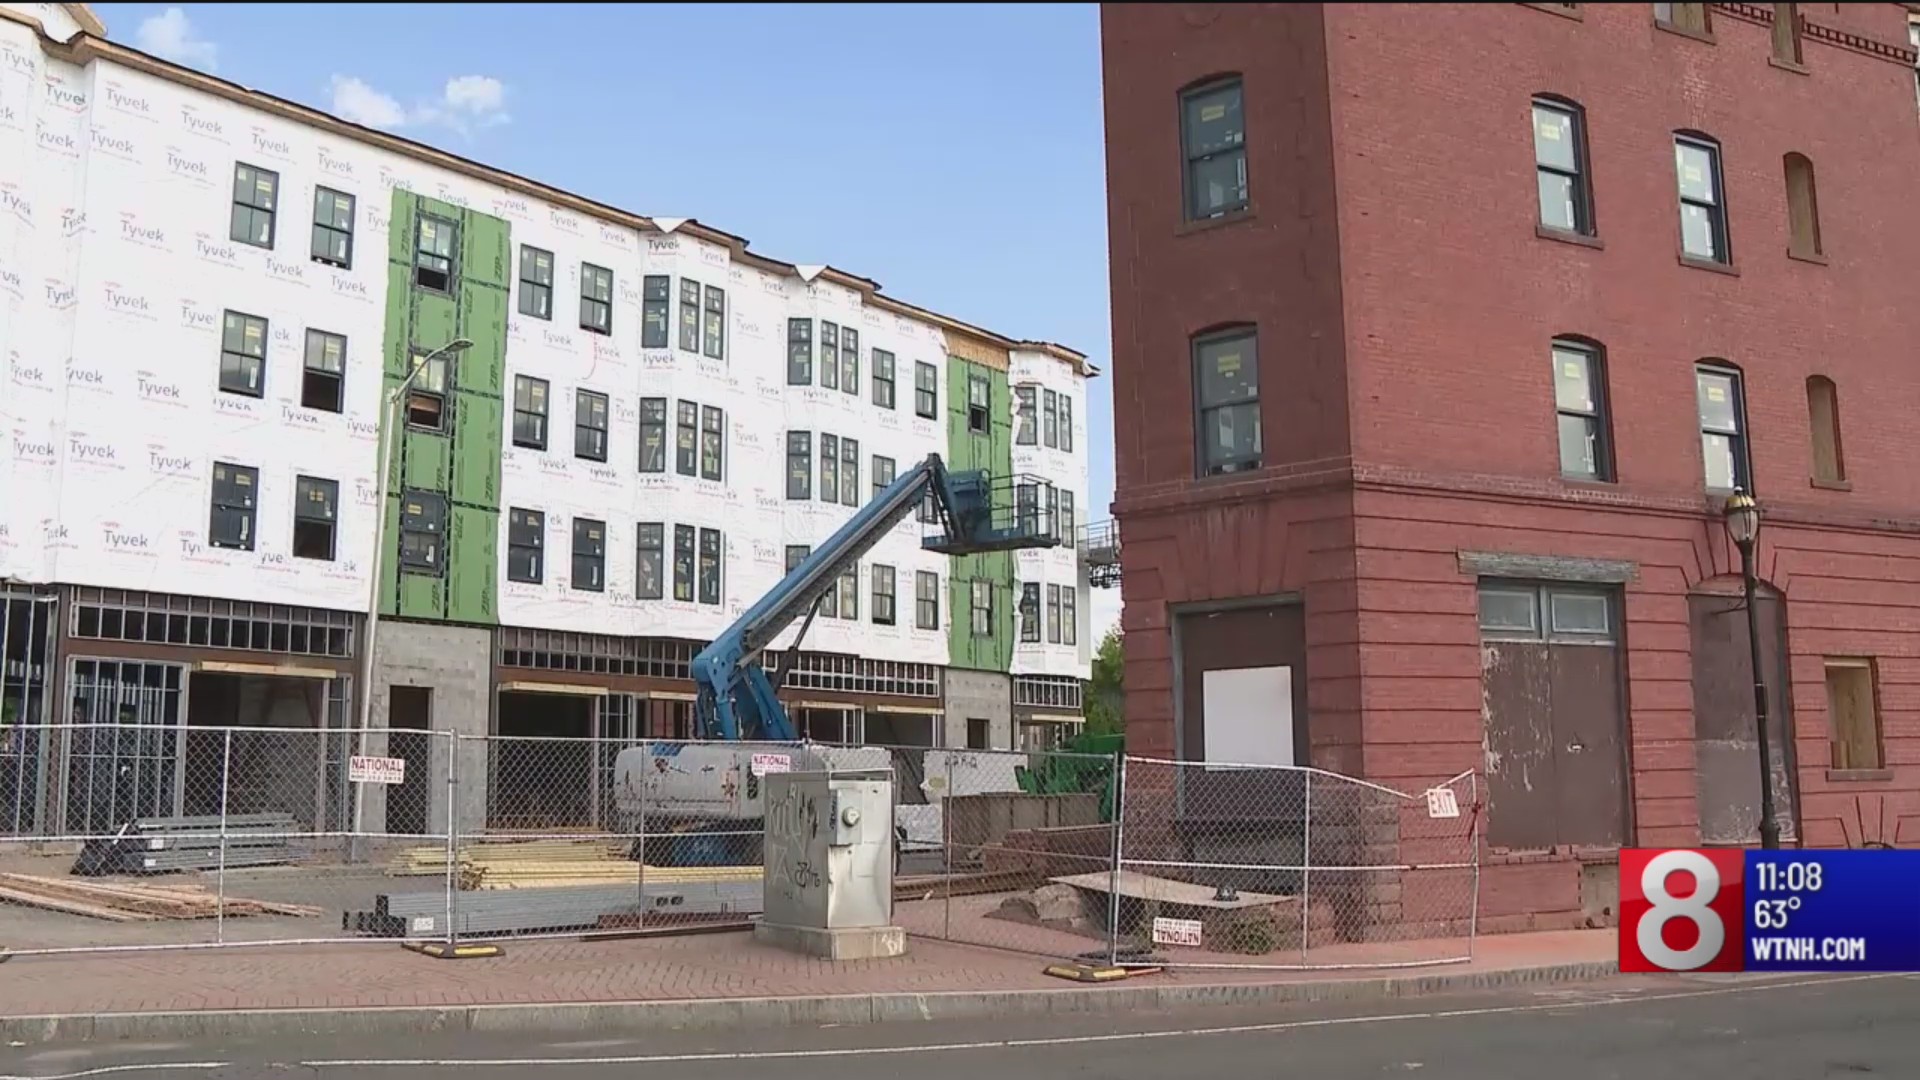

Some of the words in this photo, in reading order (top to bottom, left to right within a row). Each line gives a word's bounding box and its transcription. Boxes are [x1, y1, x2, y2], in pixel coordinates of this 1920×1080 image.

[105, 87, 150, 112] Tyvek
[181, 111, 222, 134] Tyvek
[90, 130, 134, 153] Tyvek
[252, 133, 290, 153] Tyvek
[167, 153, 207, 175] Tyvek
[318, 153, 353, 173] Tyvek
[121, 220, 163, 242] Tyvek
[196, 240, 236, 261] Tyvek
[648, 239, 680, 251] Tyvek
[266, 257, 303, 278] Tyvek
[331, 275, 367, 294] Tyvek
[105, 289, 149, 311] Tyvek
[181, 306, 214, 325] Tyve
[138, 378, 180, 398] Tyvek
[70, 440, 115, 459] Tyvek
[149, 452, 192, 470] Tyvek
[104, 530, 148, 547] Tyvek
[481, 587, 491, 616] ZIP
[352, 758, 403, 772] NATIONAL
[754, 756, 788, 766] NATIONAL
[1429, 791, 1455, 815] EXIT
[1155, 929, 1199, 944] NATIONAL
